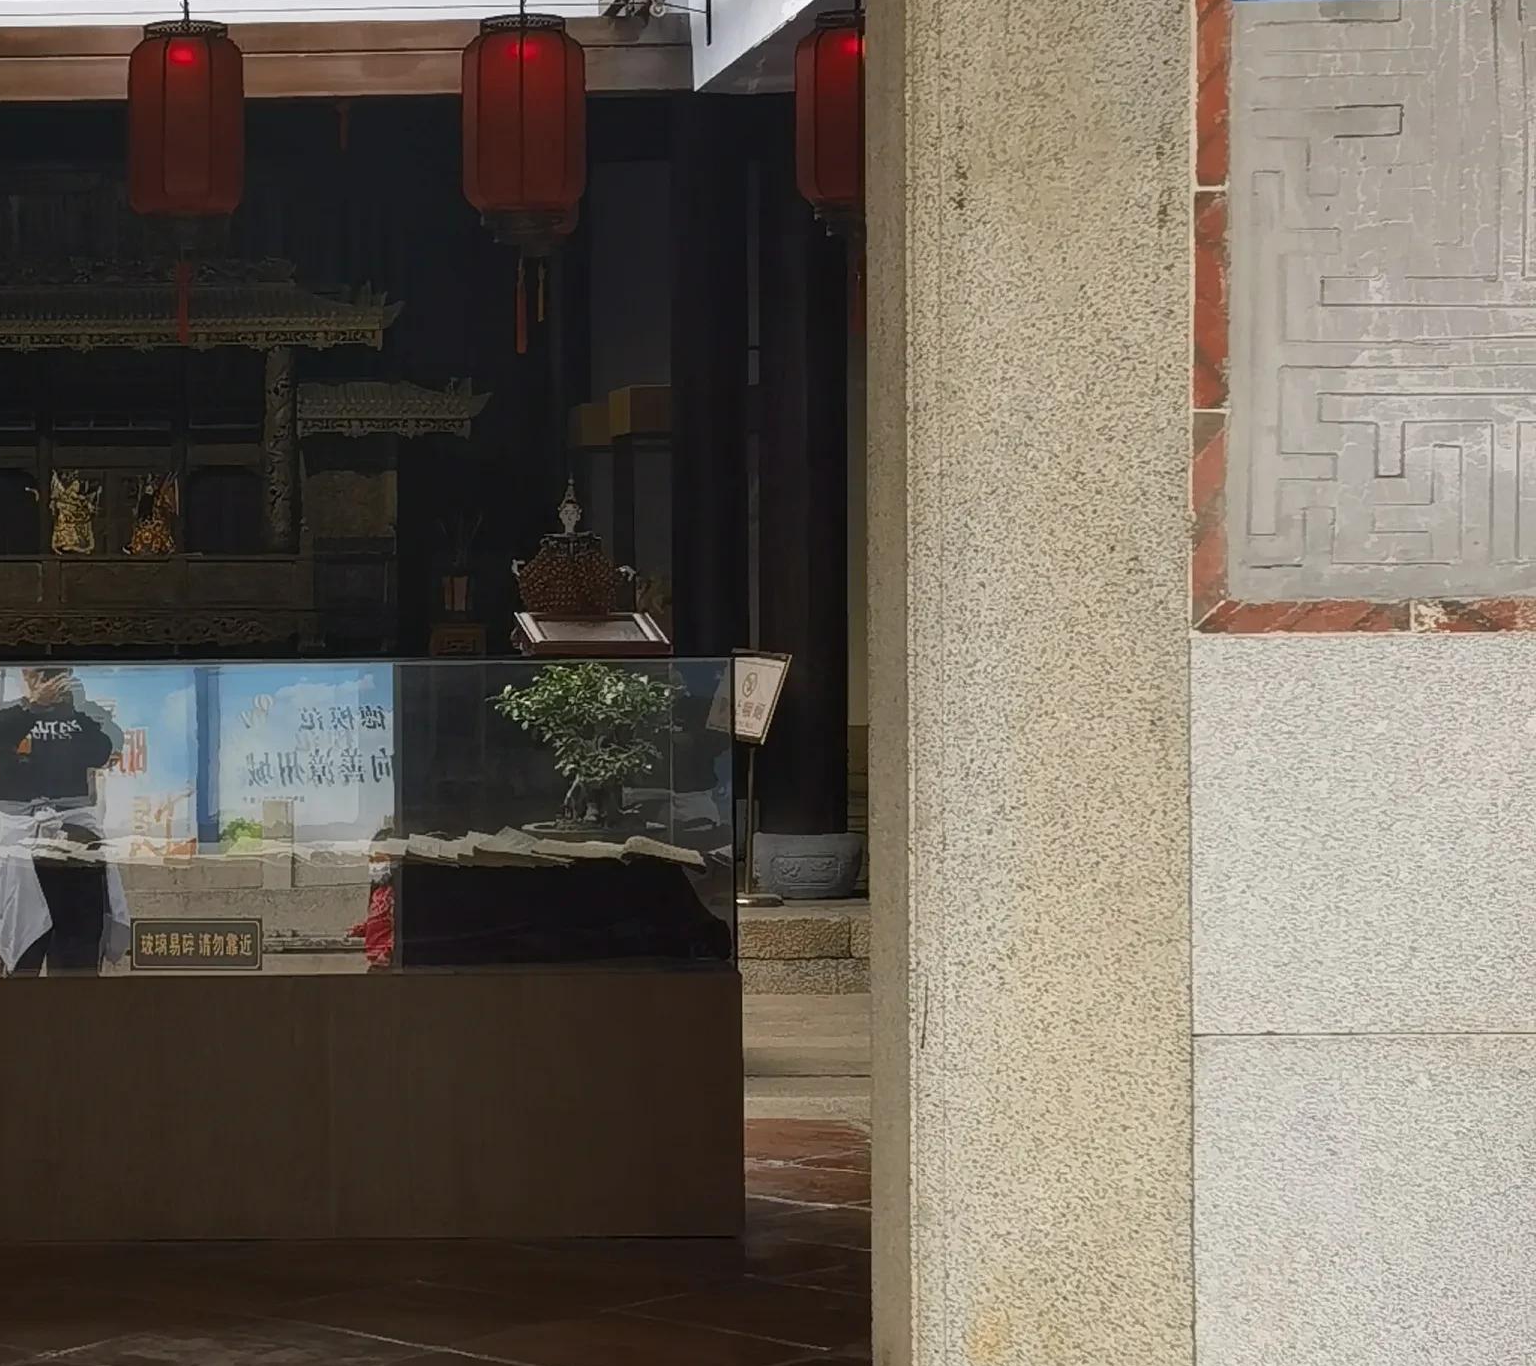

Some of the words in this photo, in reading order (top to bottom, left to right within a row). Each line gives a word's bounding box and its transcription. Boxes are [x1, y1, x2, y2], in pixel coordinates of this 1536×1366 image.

[140, 932, 196, 957] 玻璃易碎
[198, 932, 253, 957] 请勿靠近
